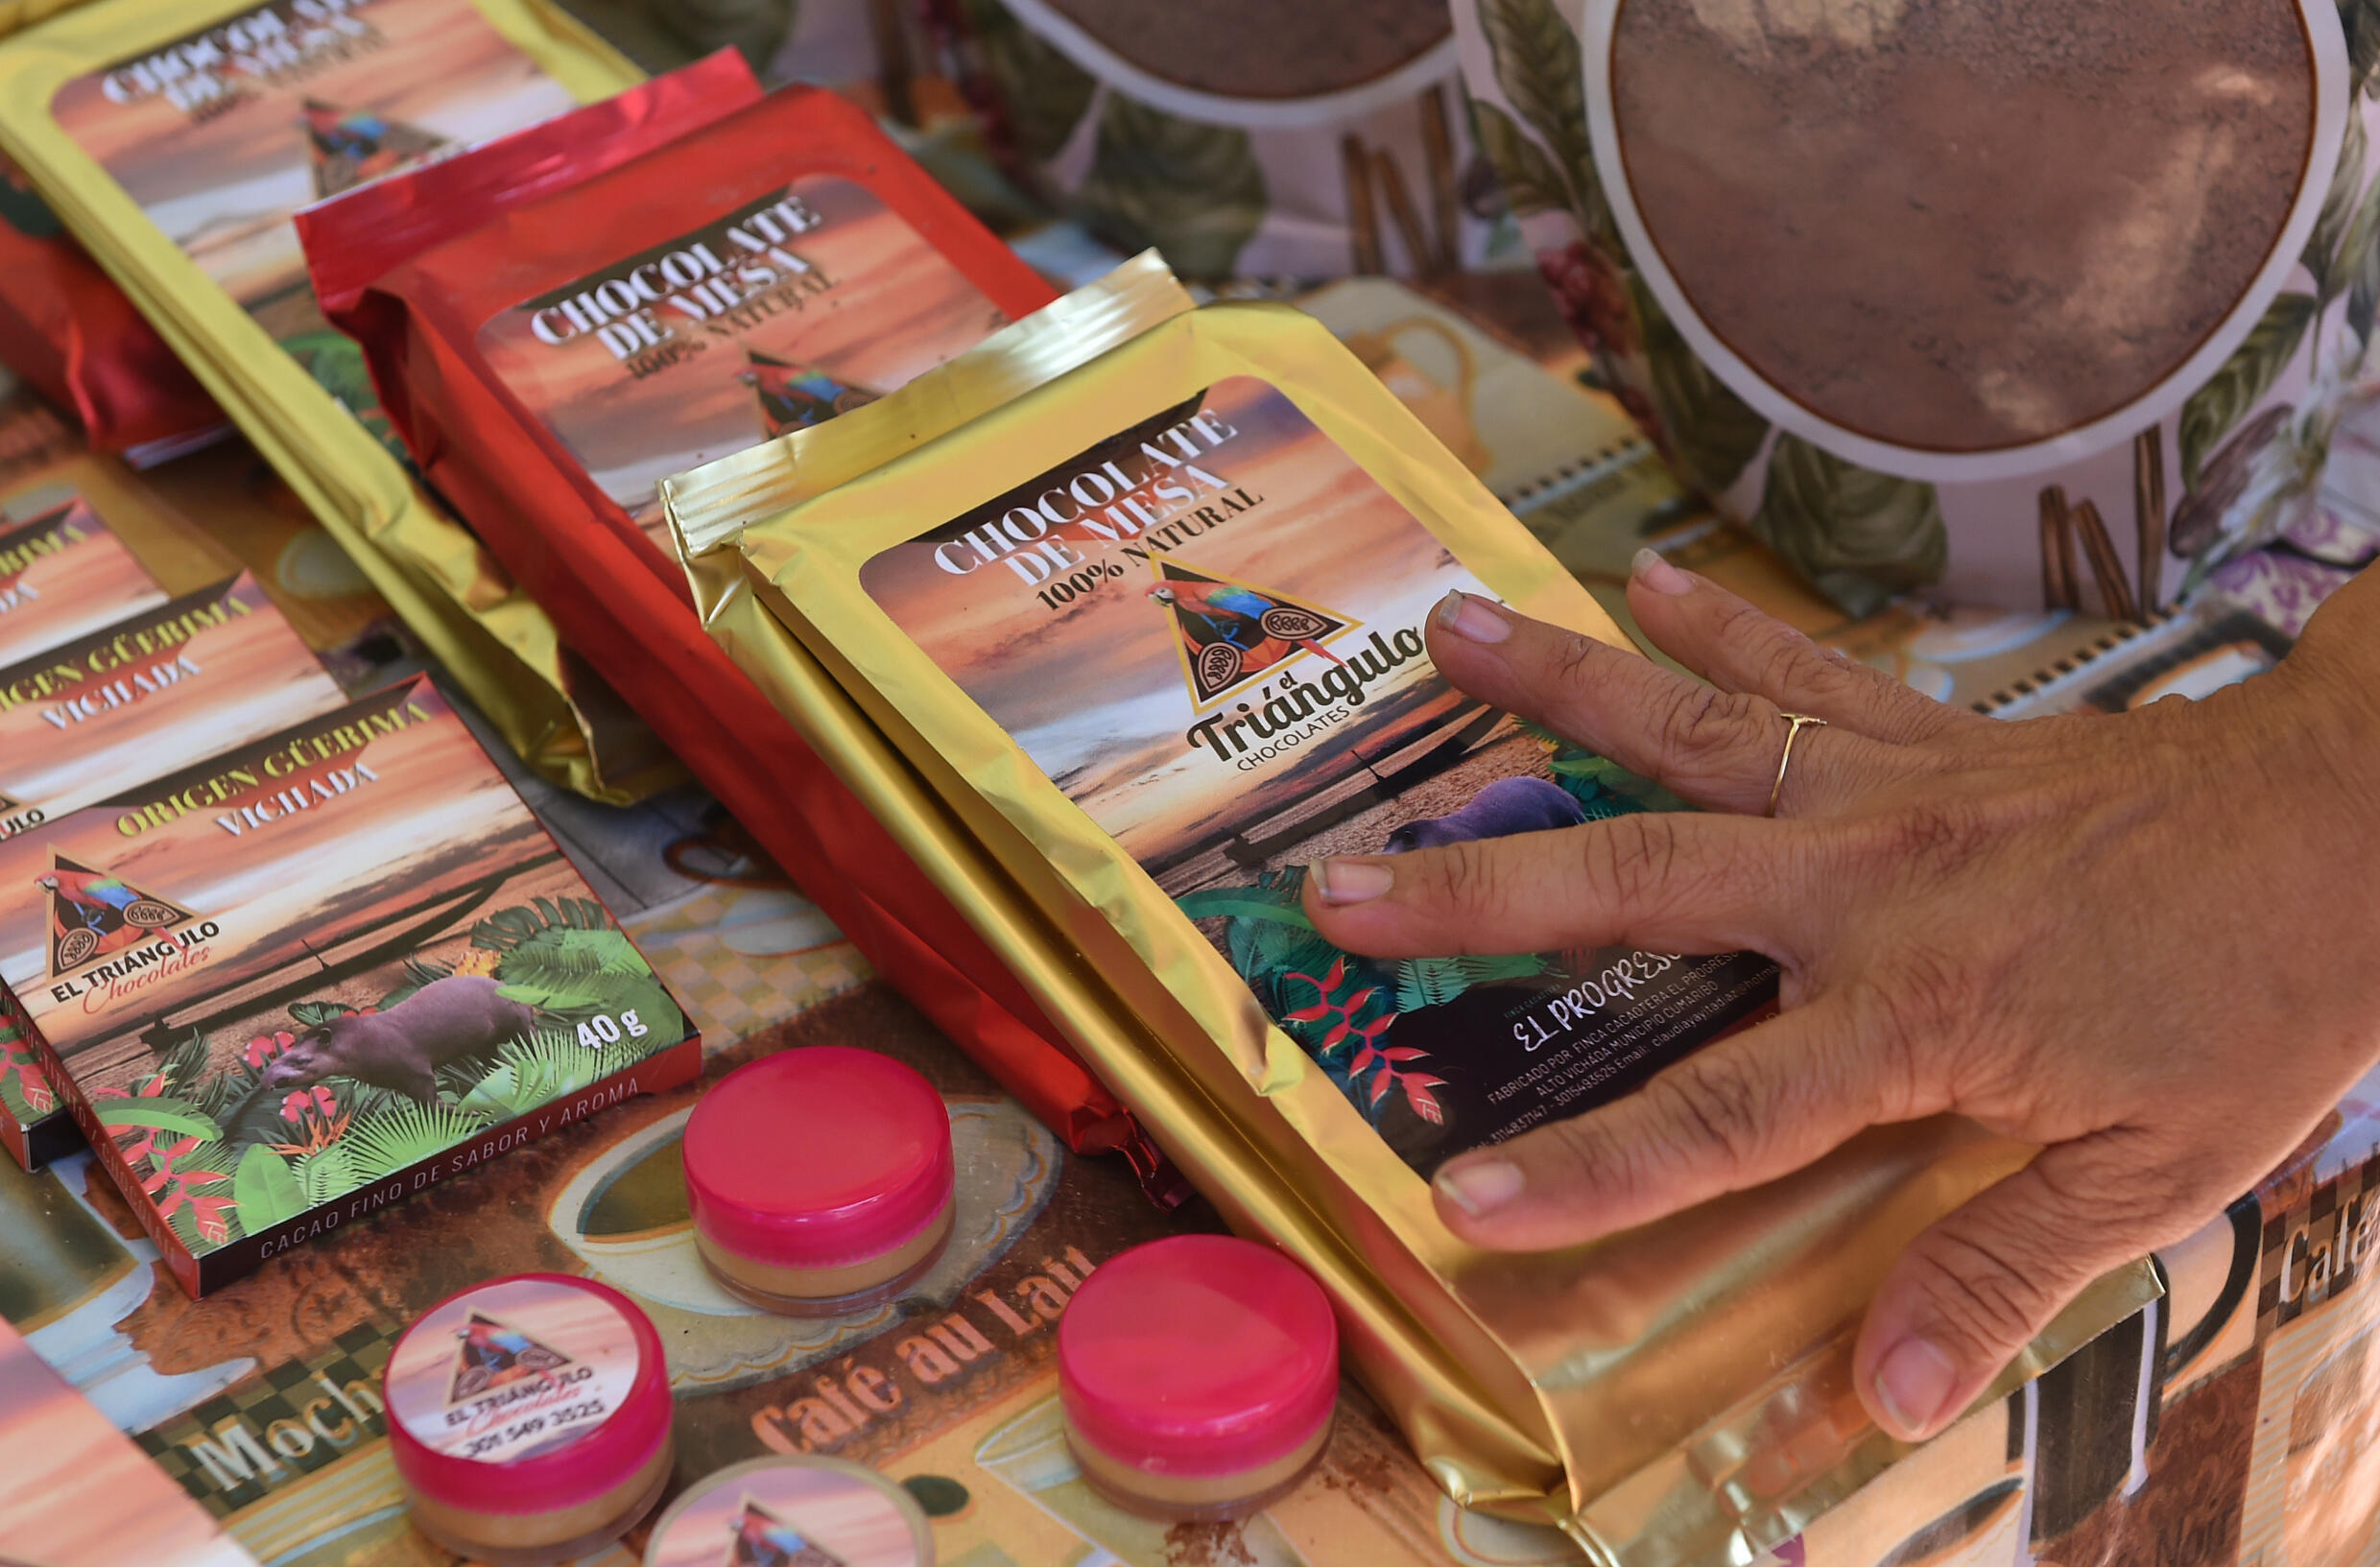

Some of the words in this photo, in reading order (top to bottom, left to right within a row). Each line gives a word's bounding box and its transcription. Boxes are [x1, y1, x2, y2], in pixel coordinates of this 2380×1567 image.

[531, 196, 821, 345] CHOCOLATE
[596, 307, 674, 361] DE
[666, 246, 810, 329] MESA
[707, 269, 842, 338] NATURAL
[934, 408, 1238, 575] CHOCOLATE
[1003, 534, 1086, 587] DE
[1079, 465, 1229, 550] MESA
[1035, 558, 1125, 610] 100%
[1120, 487, 1264, 568] NATURAL
[88, 596, 251, 673] GÜERIMA
[1278, 670, 1298, 690] el
[42, 655, 202, 730] VICHADA
[1186, 627, 1424, 763] Triángulo
[1237, 705, 1351, 772] CHOCOLATES
[117, 765, 259, 838] ORIGEN
[263, 701, 431, 778] GÜERIMA
[215, 761, 380, 837] VICHADA
[51, 982, 83, 1004] EL
[82, 921, 220, 988] TRIÁNGULO
[83, 945, 212, 1014] Chocolates
[1513, 1015, 1559, 1052] EL
[1547, 950, 1681, 1033] PROGRES
[576, 1014, 621, 1049] 40
[620, 1009, 648, 1037] g
[1488, 1063, 1551, 1105] FABRICADO
[1549, 1050, 1573, 1069] POR
[1572, 1029, 1607, 1054] FINCA
[1605, 989, 1670, 1033] CACAOTERA
[1666, 982, 1687, 996] EL
[1535, 1074, 1567, 1098] ALTO
[1608, 1012, 1667, 1052] MUNICIPIO
[1662, 980, 1720, 1020] CUMARIBO
[260, 1210, 339, 1260] CACAO
[350, 1181, 402, 1220] FINO
[414, 1161, 440, 1190] DE
[451, 1126, 529, 1174] SABOR
[538, 1115, 552, 1131] Y
[559, 1077, 640, 1125] AROMA
[2278, 1186, 2380, 1303] Café
[895, 1312, 996, 1384] au
[185, 1366, 385, 1492] Moch
[445, 1410, 469, 1427] EL
